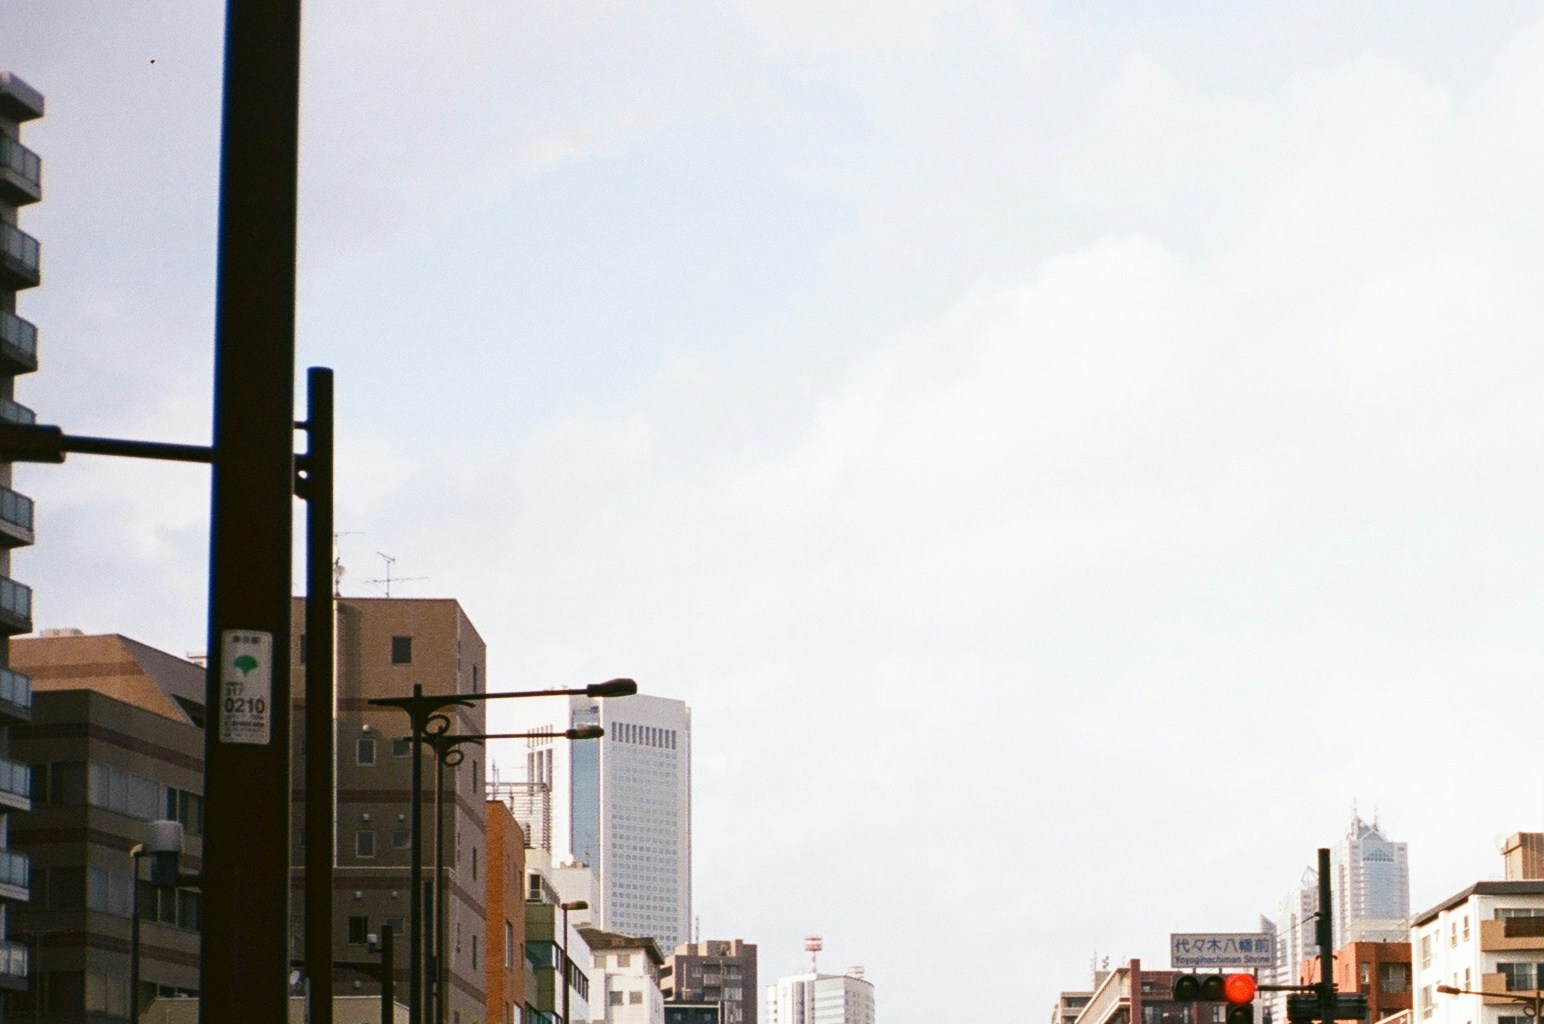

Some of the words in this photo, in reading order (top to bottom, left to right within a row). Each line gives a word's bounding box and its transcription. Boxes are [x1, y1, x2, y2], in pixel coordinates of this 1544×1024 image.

[224, 697, 265, 714] 0210
[1174, 938, 1270, 953] 代々木八幡前
